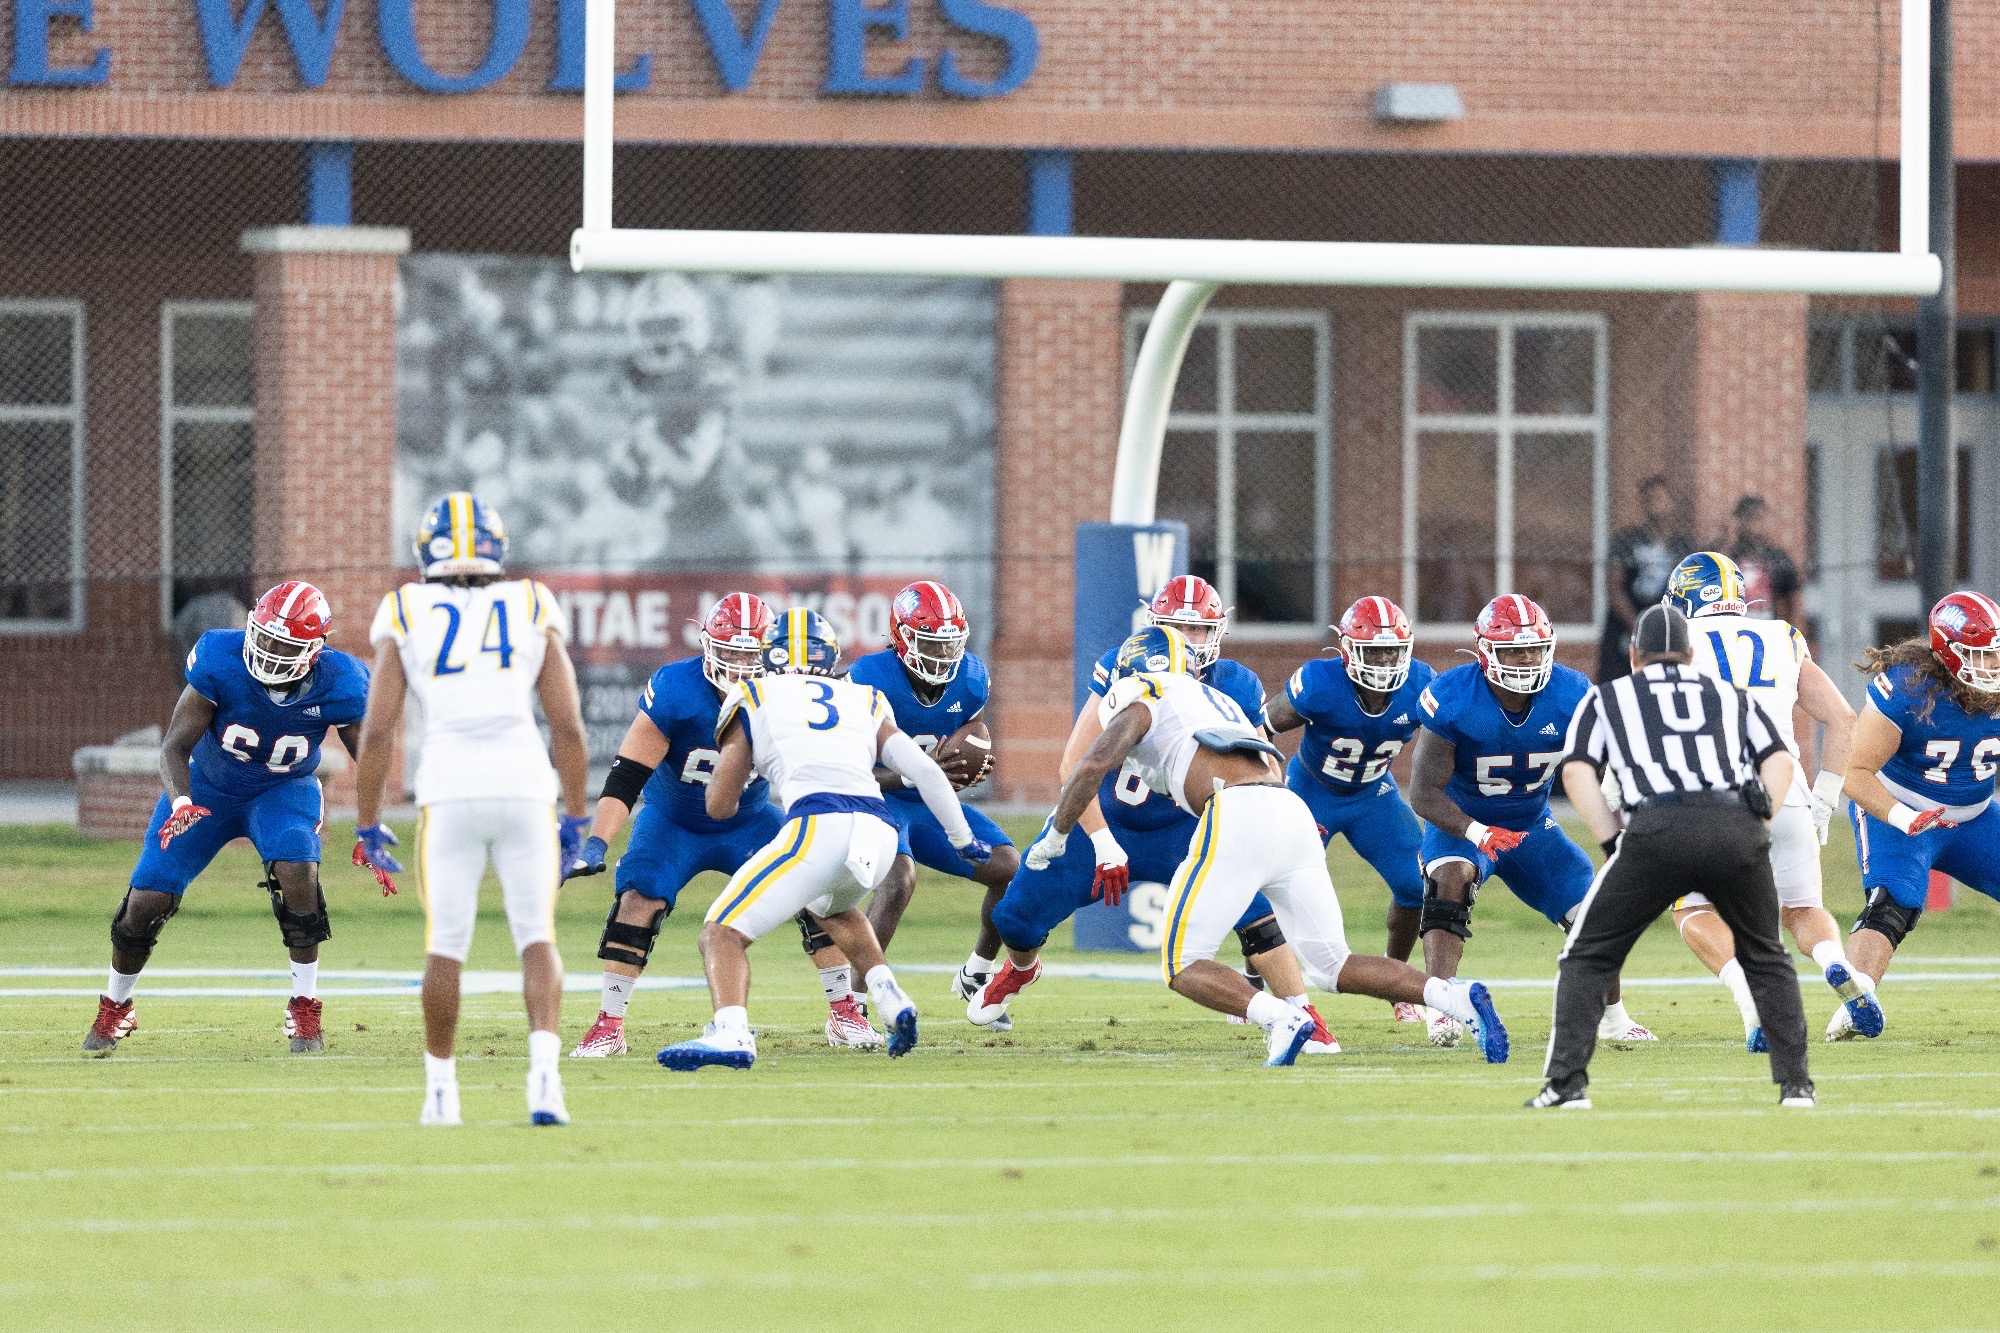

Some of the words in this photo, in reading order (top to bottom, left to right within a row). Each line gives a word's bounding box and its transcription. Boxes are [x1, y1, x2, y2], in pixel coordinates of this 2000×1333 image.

[430, 598, 515, 678] 24
[1704, 629, 1776, 688] 12
[804, 680, 840, 731] 3
[1648, 682, 1706, 732] U
[221, 724, 309, 773] 60
[680, 746, 759, 792] 6
[1321, 737, 1405, 784] 22
[1922, 736, 2000, 784] 76
[1475, 751, 1564, 797] 57
